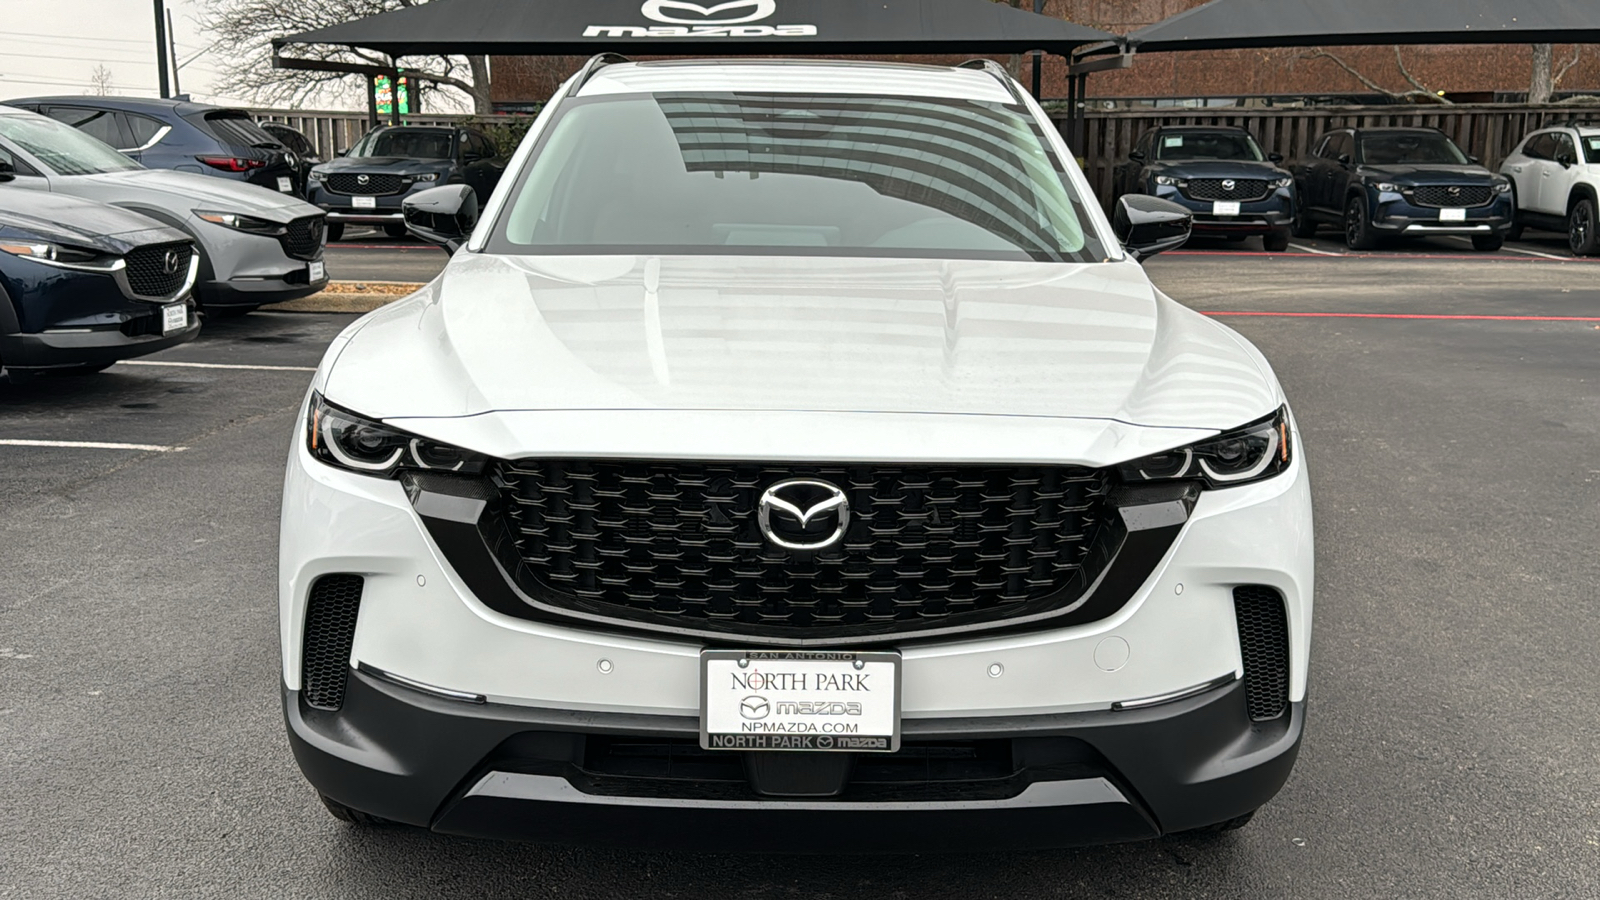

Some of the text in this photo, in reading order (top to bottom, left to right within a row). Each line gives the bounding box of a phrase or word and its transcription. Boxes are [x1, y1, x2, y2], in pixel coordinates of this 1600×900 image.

[749, 652, 853, 661] SAN ANTONIO
[731, 672, 871, 692] NORTH PARK
[741, 722, 858, 733] NPMAZDA.COM
[712, 735, 767, 748] NORTH
[771, 735, 813, 748] PARK
